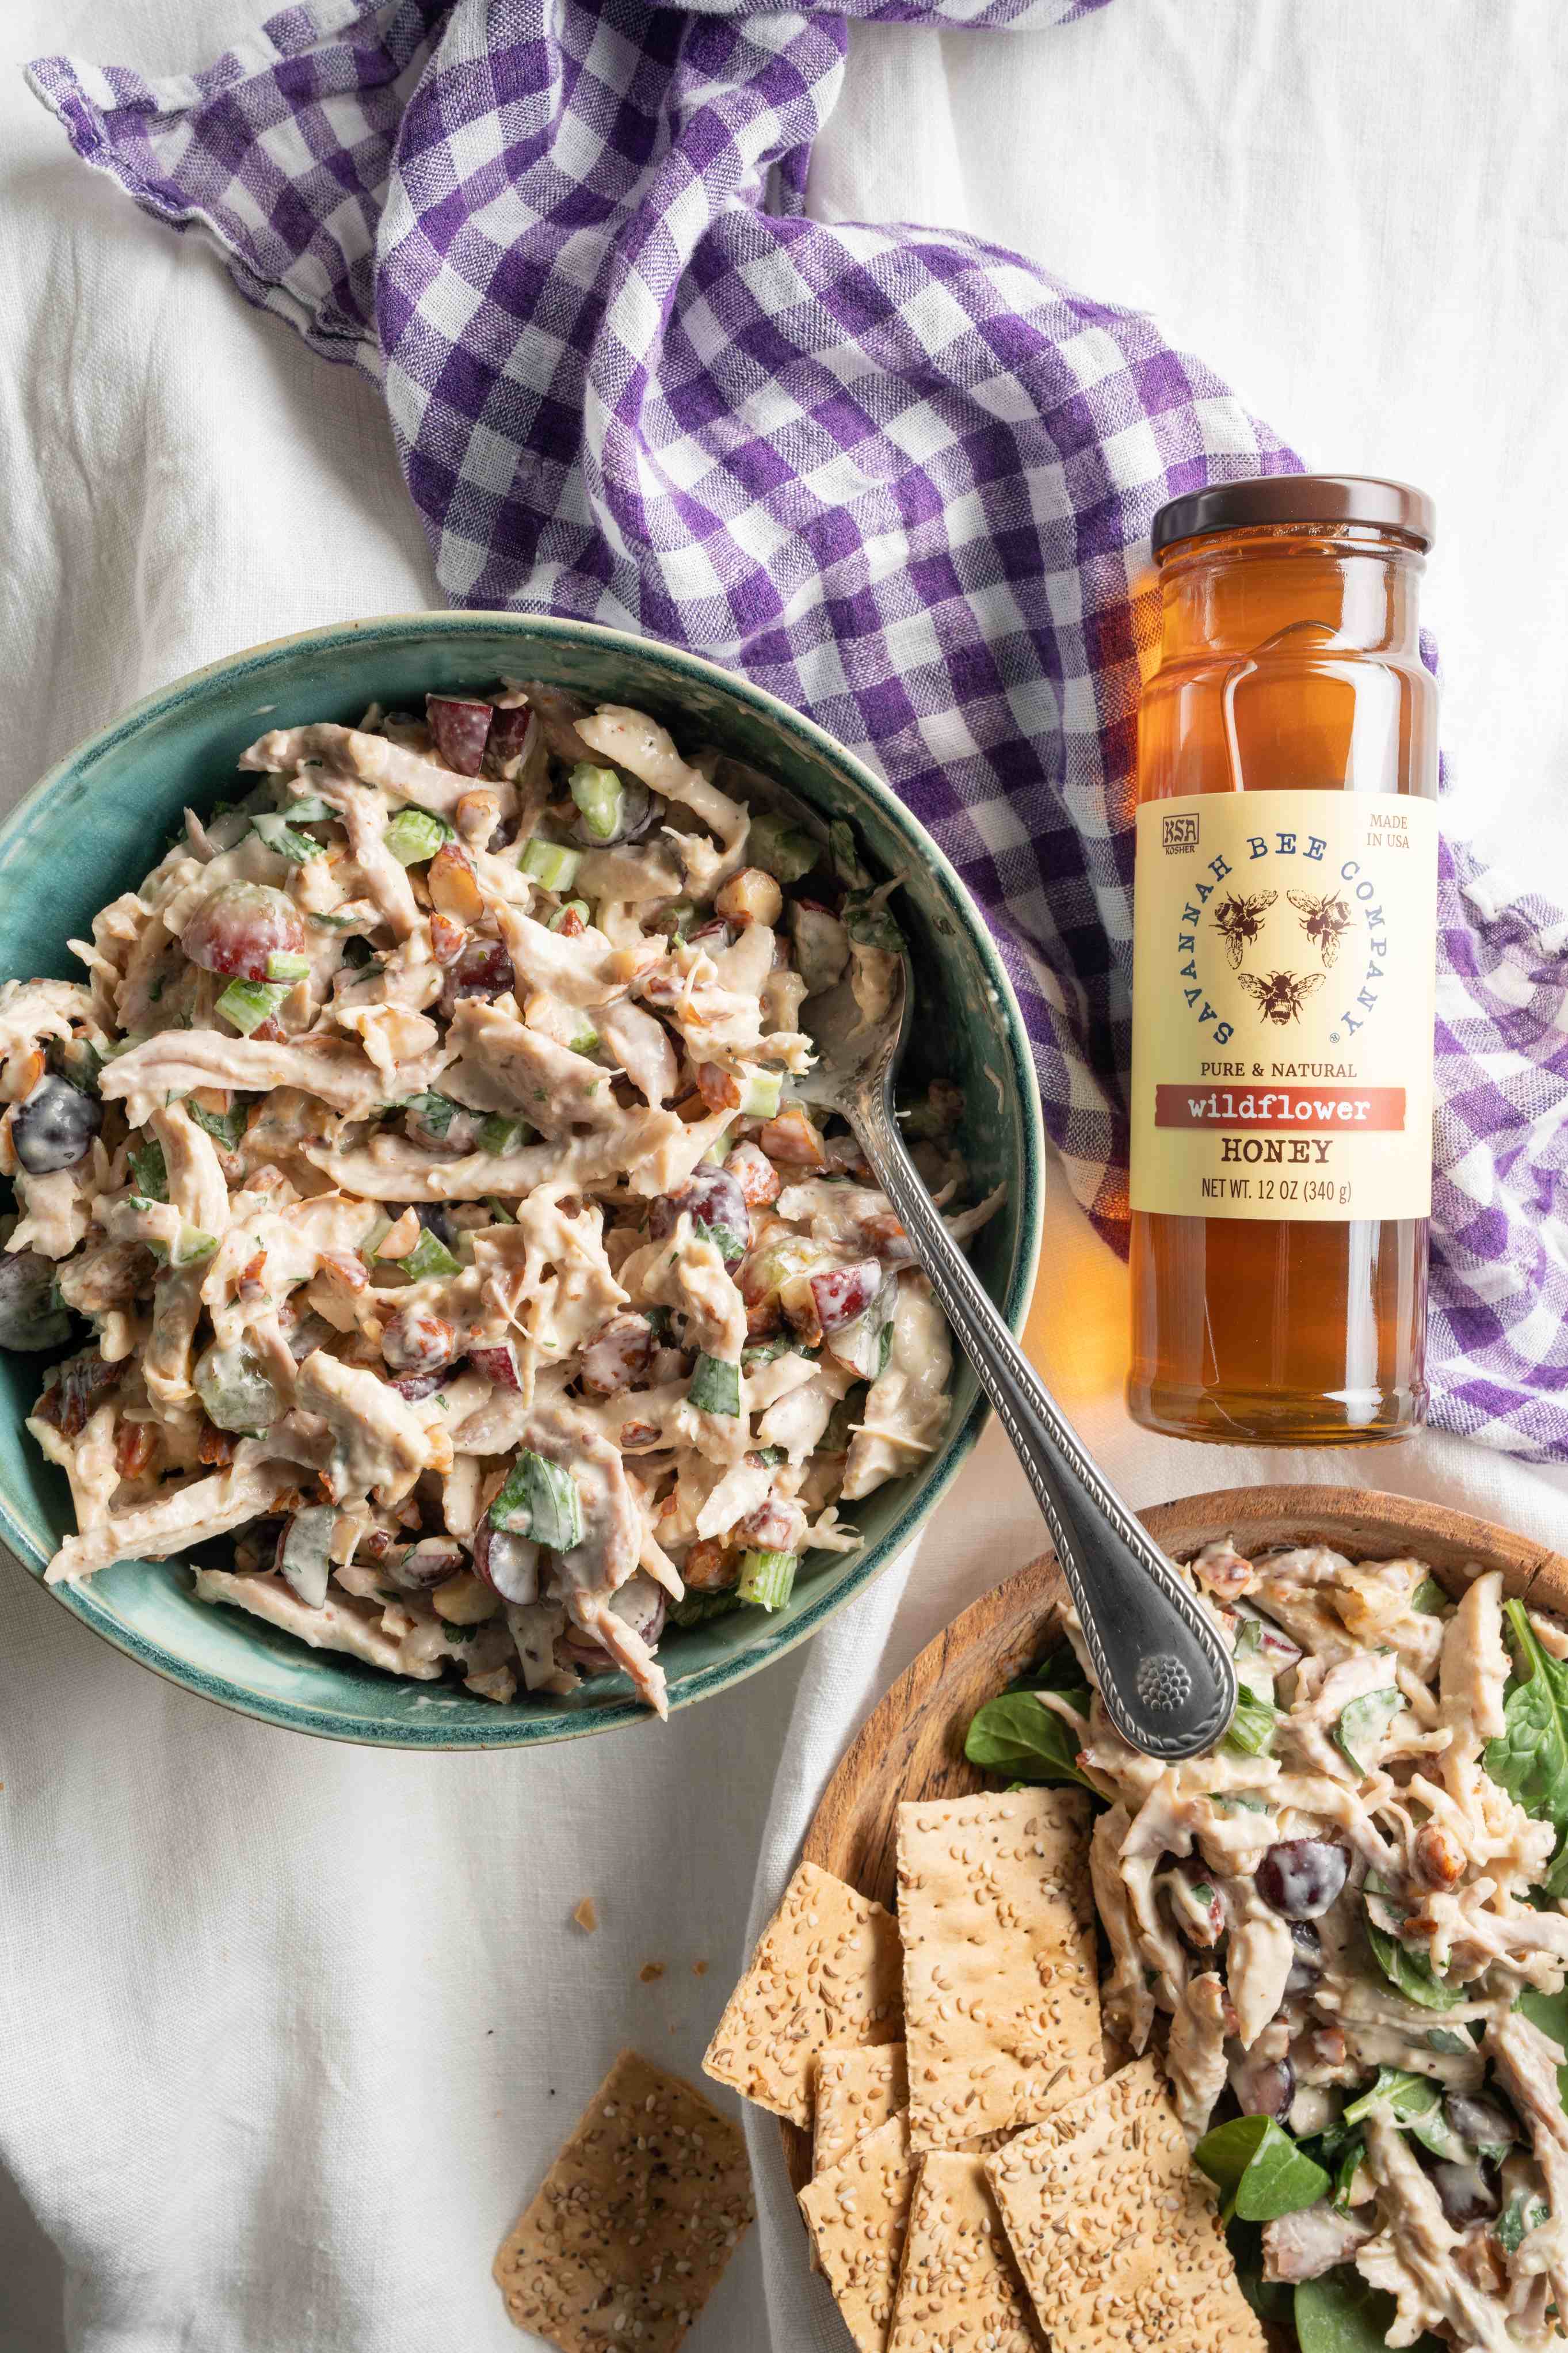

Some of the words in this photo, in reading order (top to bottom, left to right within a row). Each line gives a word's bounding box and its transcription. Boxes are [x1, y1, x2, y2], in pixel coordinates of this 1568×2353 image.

[1369, 813, 1408, 829] MADE
[1165, 845, 1196, 855] KOSHER
[1367, 833, 1382, 846] IN
[1387, 834, 1409, 848] USA
[1178, 855, 1234, 1045] SAVANNAH
[1246, 833, 1327, 861] BEE
[1341, 861, 1387, 1037] COMPANY
[1201, 1062, 1245, 1077] PURE
[1252, 1063, 1265, 1077] &
[1271, 1063, 1357, 1078] NATURAL
[1188, 1093, 1371, 1121] wildflower
[1220, 1137, 1333, 1164] HONEY
[1202, 1178, 1226, 1198] NET
[1230, 1179, 1252, 1200] WT.
[1258, 1181, 1275, 1200] 12
[1279, 1181, 1299, 1201] OZ
[1304, 1181, 1334, 1203] (340
[1339, 1181, 1352, 1205] g)
